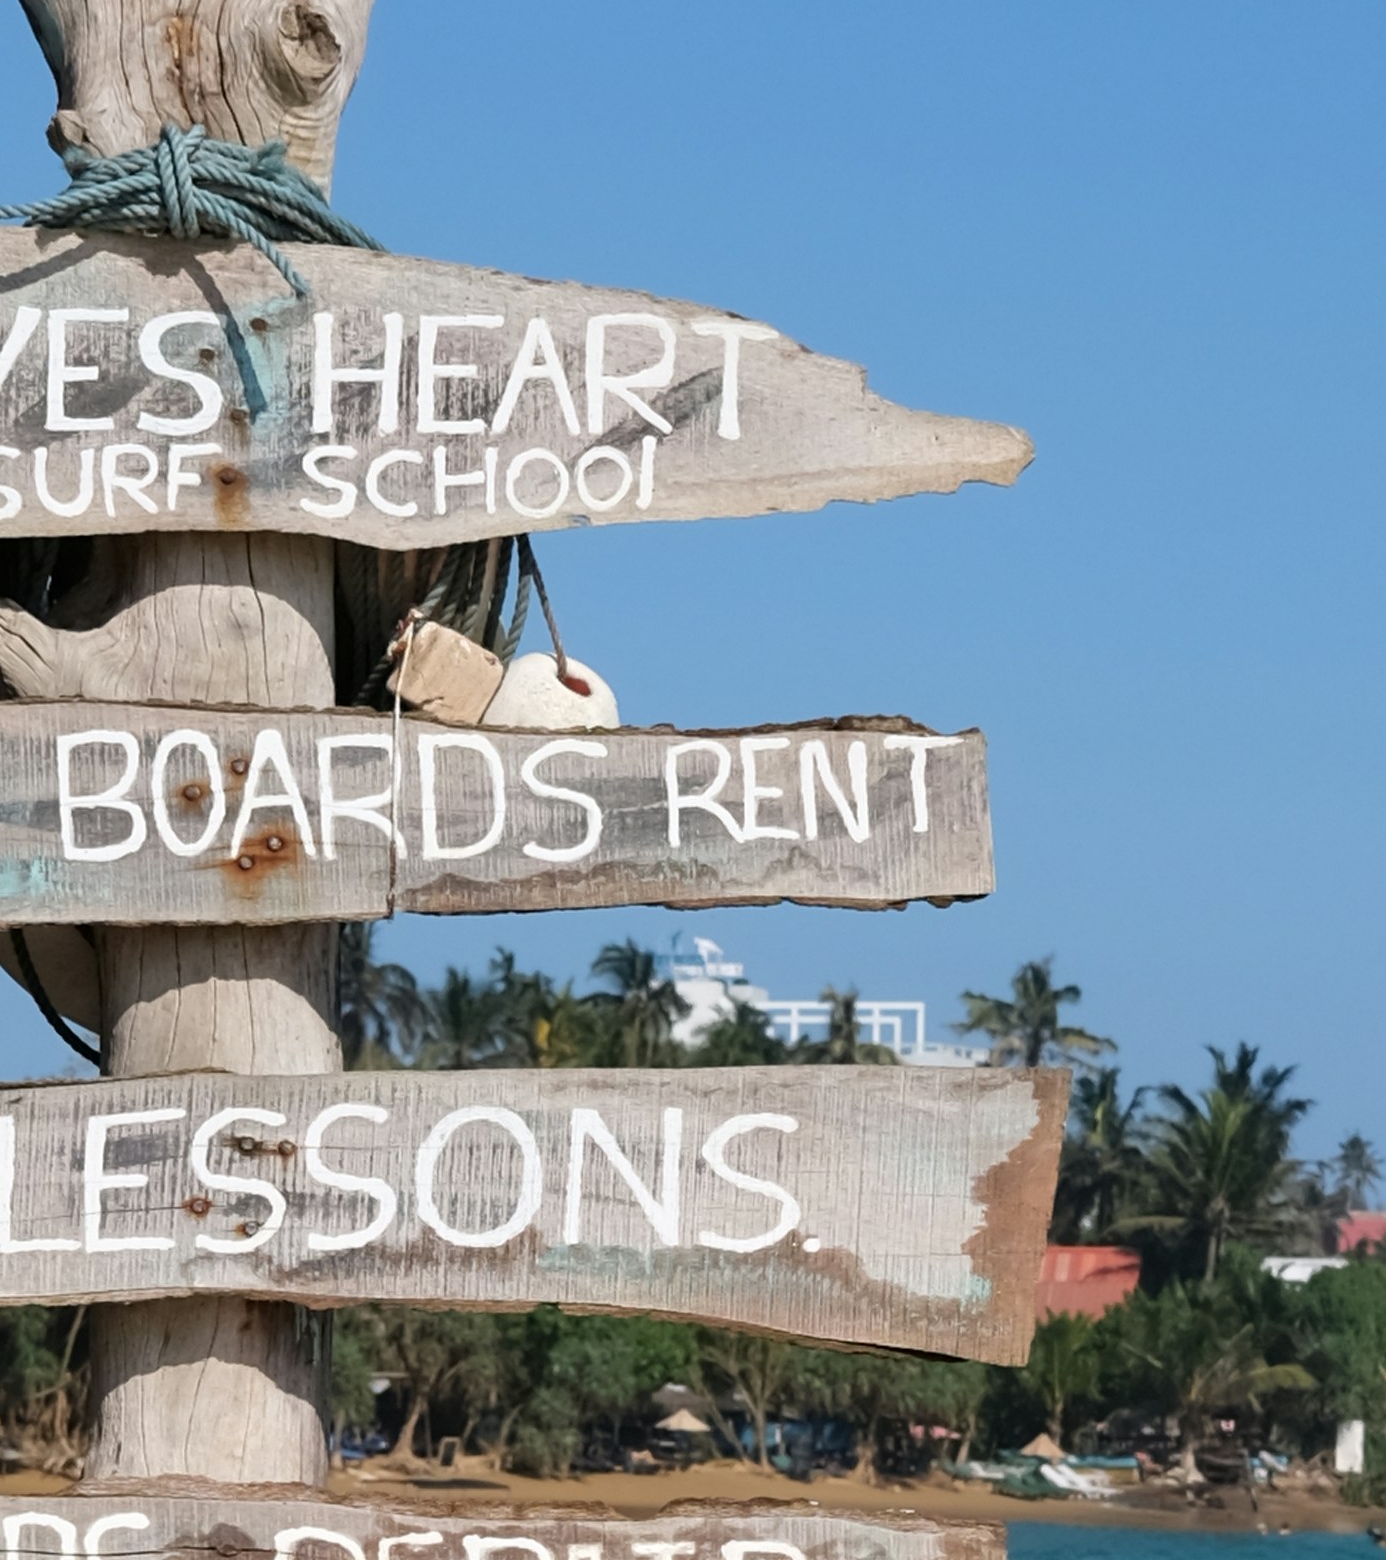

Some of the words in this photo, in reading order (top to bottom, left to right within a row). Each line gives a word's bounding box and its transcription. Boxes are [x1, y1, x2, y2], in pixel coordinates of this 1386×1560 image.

[312, 311, 780, 439] HEART
[56, 727, 608, 865] BOARDS
[664, 732, 964, 847] RENT
